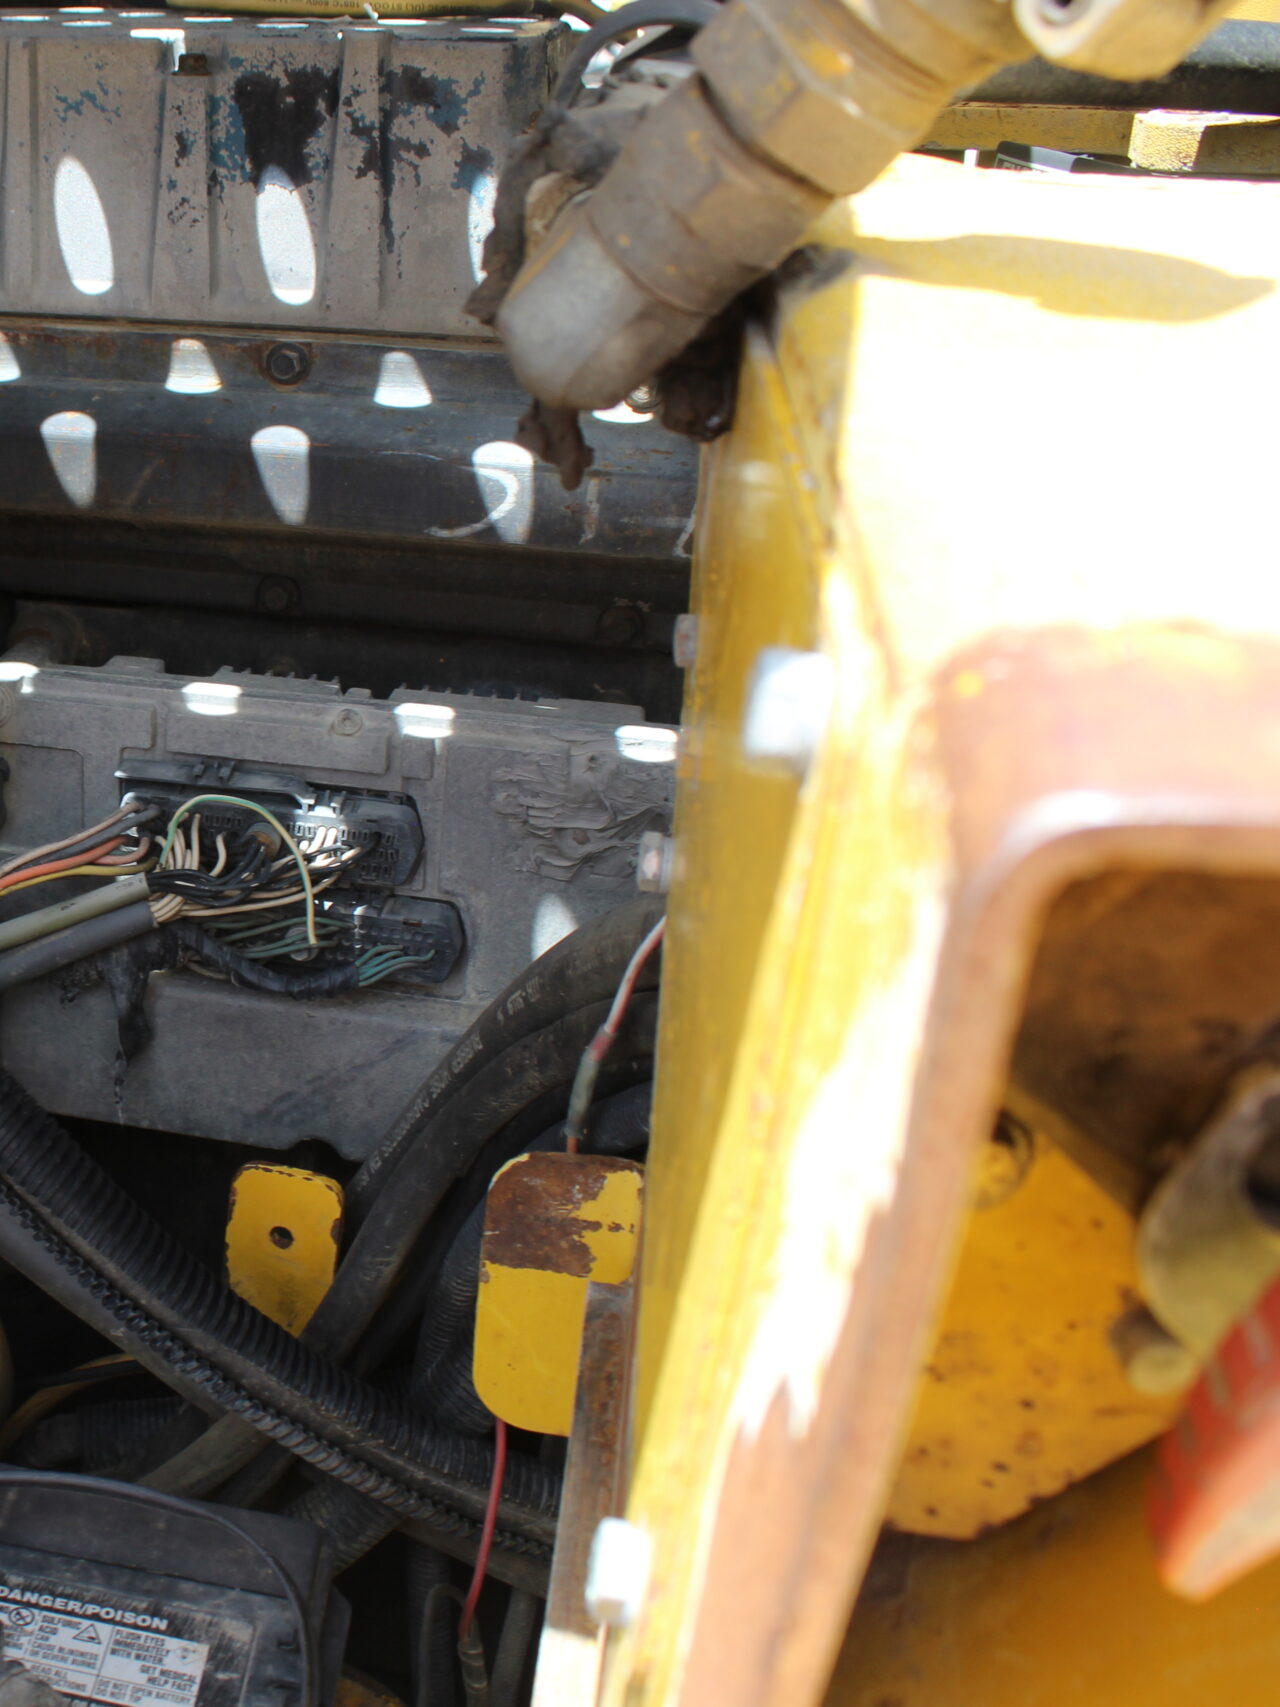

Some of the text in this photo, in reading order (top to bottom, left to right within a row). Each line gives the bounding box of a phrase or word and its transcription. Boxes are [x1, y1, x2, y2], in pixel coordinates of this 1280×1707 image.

[39, 1624, 59, 1635] ACID
[42, 1614, 83, 1630] SULFURIC
[115, 1629, 166, 1647] FLUSH EYES
[110, 1648, 131, 1659] WITH
[113, 1638, 170, 1657] IMMEDIATELY
[139, 1664, 197, 1684] GET MEDICAL
[147, 1676, 169, 1688] HELP
